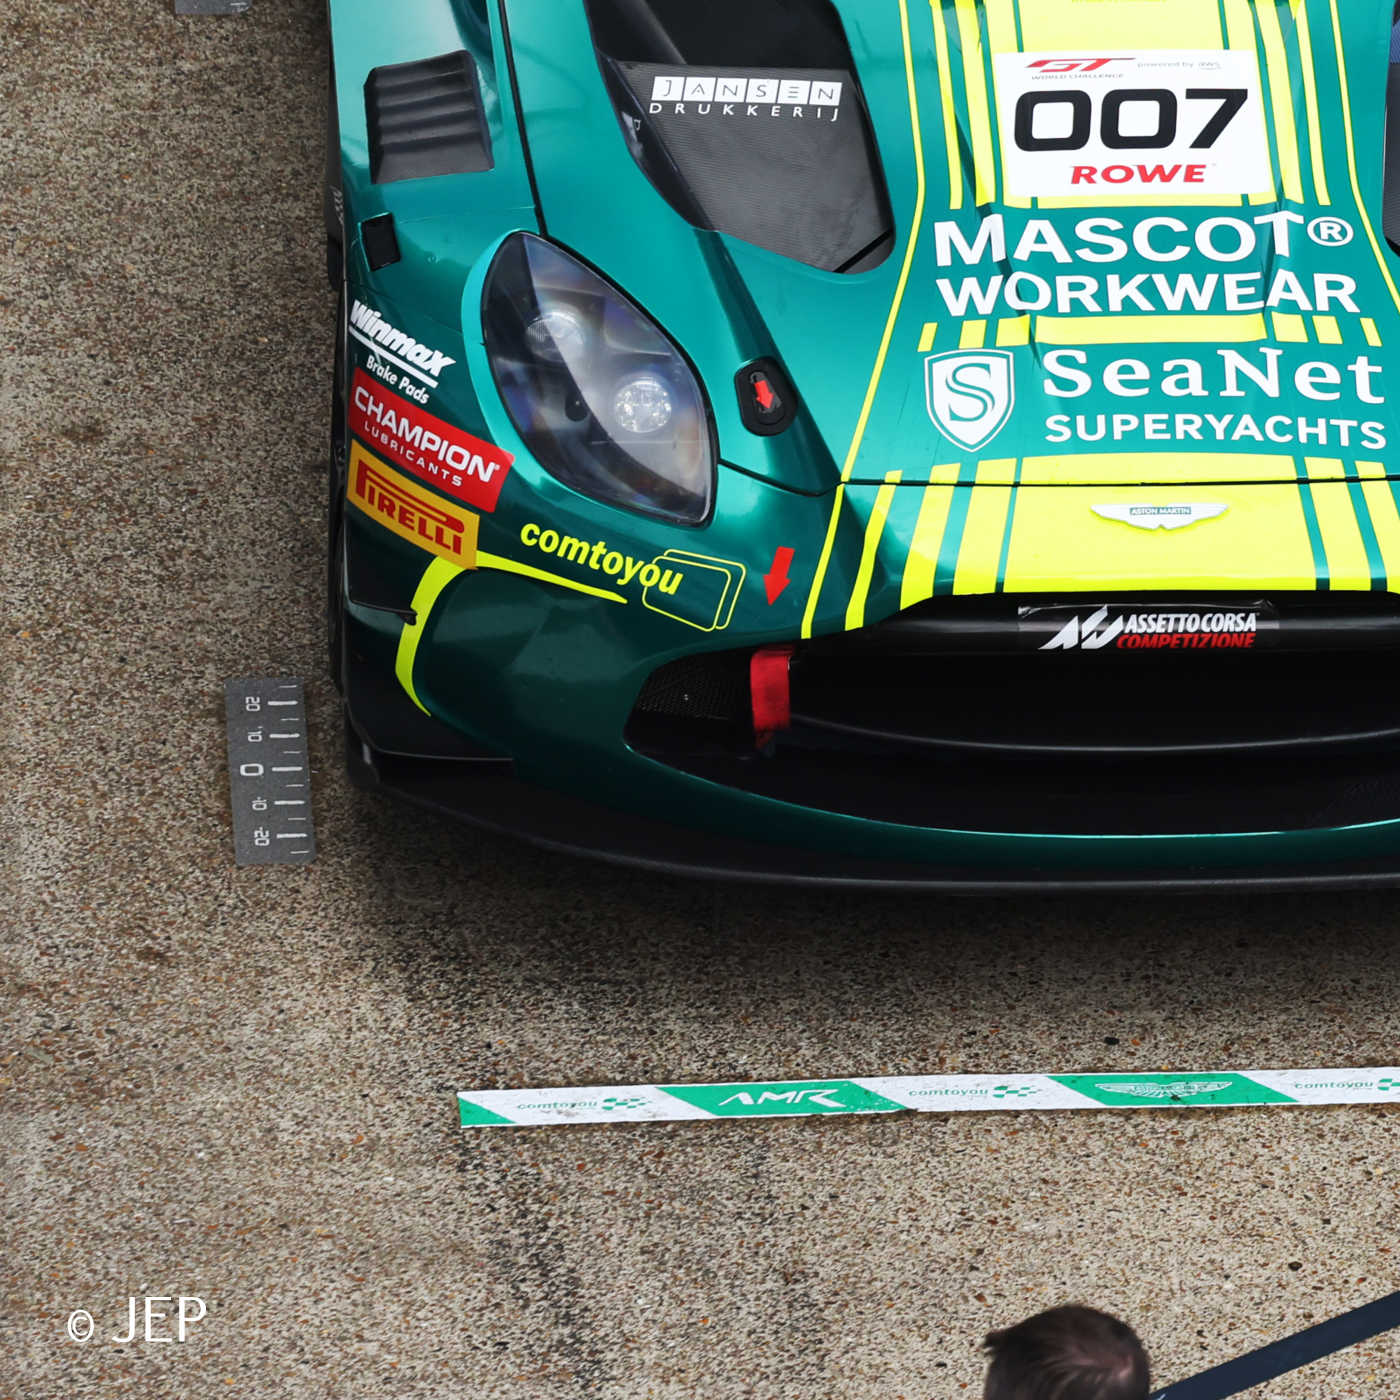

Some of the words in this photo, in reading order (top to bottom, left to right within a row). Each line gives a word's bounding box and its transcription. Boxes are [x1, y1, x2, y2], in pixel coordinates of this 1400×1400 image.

[1025, 57, 1135, 72] GT
[649, 103, 840, 122] DRUKKERIJ
[1014, 88, 1248, 152] 007
[1070, 163, 1207, 184] ROWE
[935, 269, 1360, 317] WORKWEAR
[350, 300, 456, 377] Winmax
[366, 355, 398, 388] Brake
[399, 376, 430, 405] Pads
[1043, 346, 1384, 404] SeaNet
[354, 385, 494, 482] CHAMPION
[1044, 413, 1387, 449] SUPERYACHTS
[364, 422, 463, 487] LUBRICANTS
[356, 459, 465, 555] PIRELLI
[1130, 507, 1158, 515] ASTON
[1159, 507, 1191, 515] MARTIN
[520, 523, 684, 595] comtoyou
[1124, 613, 1201, 633] ASSETTO
[1201, 612, 1256, 632] CORSA
[1117, 633, 1255, 649] COMPETIZIONE
[909, 1088, 989, 1098] comtoyou
[1294, 1078, 1374, 1090] comtoyou
[517, 1099, 598, 1111] comtoyou
[717, 1089, 845, 1109] AMR
